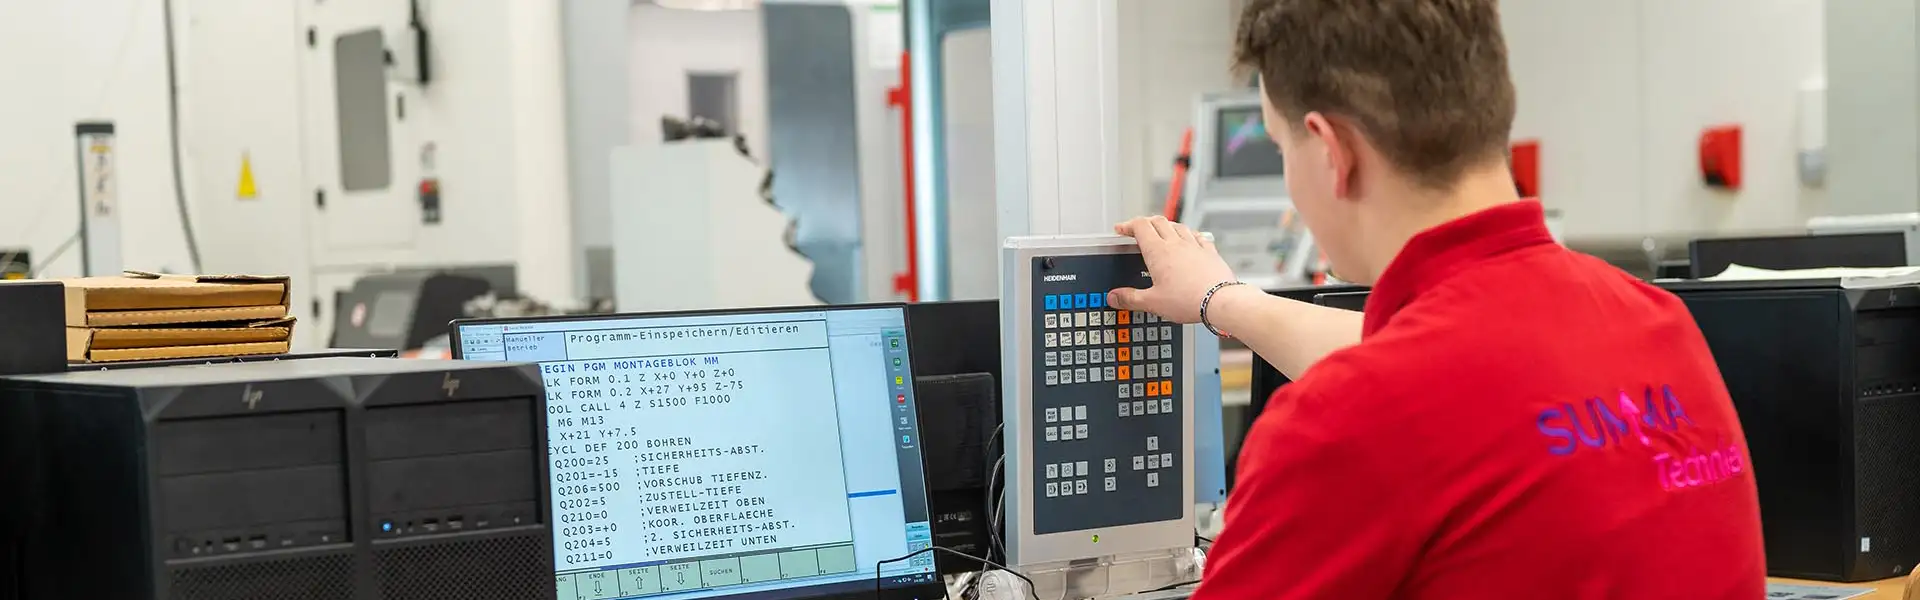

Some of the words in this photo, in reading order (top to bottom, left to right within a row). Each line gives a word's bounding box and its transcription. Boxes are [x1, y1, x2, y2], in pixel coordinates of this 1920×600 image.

[1043, 274, 1077, 282] HEIDENHAIN
[506, 335, 545, 343] Manueller
[570, 325, 799, 345] Programm-Einspeichern/Editieren
[544, 364, 575, 374] EGIN
[584, 362, 606, 372] PGM
[614, 358, 697, 370] MONTAGEBLOK
[704, 356, 719, 365] MM
[570, 376, 600, 386] FORM
[608, 374, 630, 384] 0.1
[639, 373, 646, 382] Z
[654, 371, 676, 381] X+0
[683, 370, 706, 380] Y+0
[714, 368, 735, 378] Z+0
[571, 389, 601, 399] FORM
[610, 387, 632, 397] 0.2
[640, 385, 670, 395] X+27
[678, 382, 707, 393] Y+95
[715, 380, 744, 391] Z-75
[580, 402, 610, 412] CALL
[619, 401, 626, 409] 4
[635, 400, 641, 409] Z
[650, 397, 687, 408] S1500
[695, 394, 731, 405] F1000
[558, 417, 573, 427] M6
[581, 415, 604, 426] M13
[560, 430, 590, 441] X+21
[599, 426, 637, 438] Y+7.5
[585, 442, 607, 453] DEF
[616, 440, 638, 450] 200
[646, 437, 692, 448] BOHREN
[555, 455, 609, 469] Q200=25
[556, 468, 618, 482] Q201=-15
[558, 482, 620, 496] Q206=500
[711, 470, 767, 483] TIEFENZ.
[559, 496, 606, 510] Q202=5
[561, 510, 608, 523] Q210=0
[736, 496, 765, 507] OBEN
[563, 523, 617, 537] Q203=+0
[693, 508, 773, 524] OBERFLAECHE
[564, 537, 611, 551] Q204=5
[673, 520, 795, 539] SICHERHEITS-ABST.
[566, 550, 613, 564] Q211=0
[741, 534, 778, 546] UNTEN
[589, 572, 605, 580] ENDE
[709, 568, 733, 576] SUCHEN
